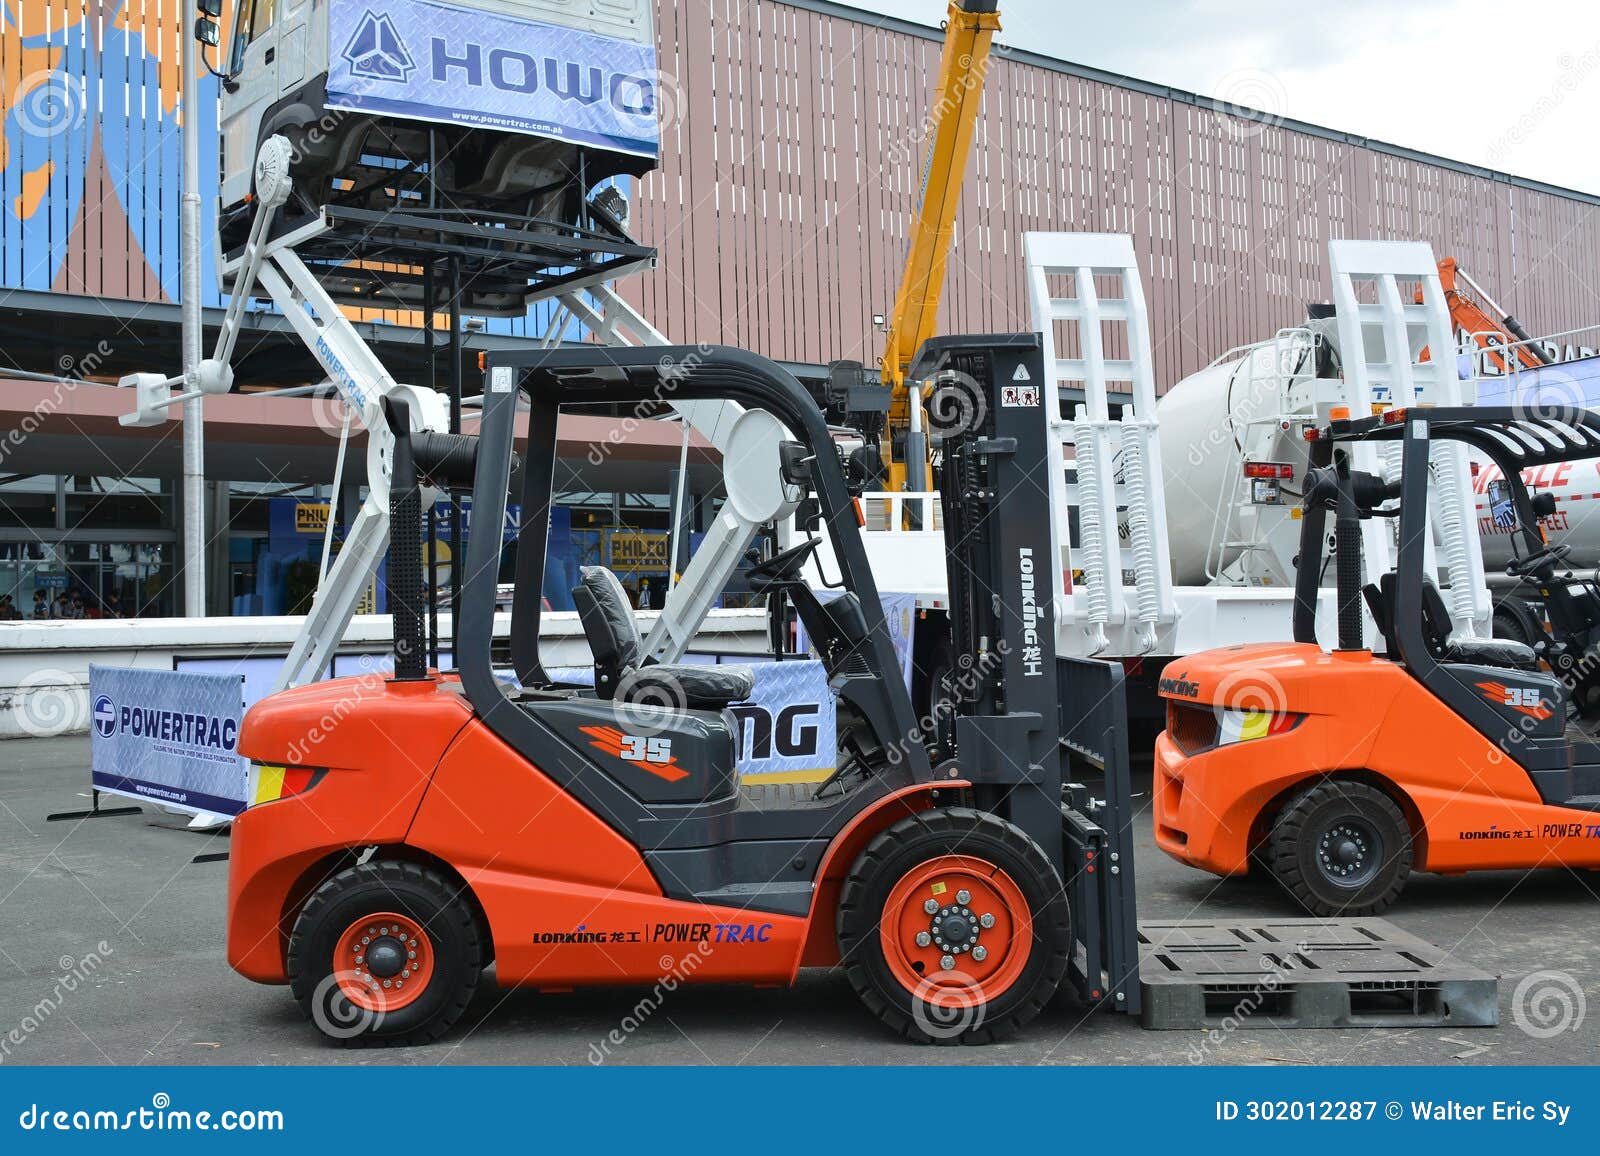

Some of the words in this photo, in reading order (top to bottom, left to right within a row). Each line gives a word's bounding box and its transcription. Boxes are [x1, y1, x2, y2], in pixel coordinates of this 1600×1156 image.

[431, 35, 654, 117] HOWO
[452, 111, 563, 136] www.powertrac.com.ph
[297, 508, 331, 522] PHIL
[1504, 687, 1540, 707] 35
[120, 706, 237, 751] POWERTRAC
[620, 735, 672, 764] 35
[1542, 823, 1583, 838] POWER
[610, 931, 641, 943] 龙工
[653, 923, 711, 943] POWER
[714, 923, 773, 943] TRAC
